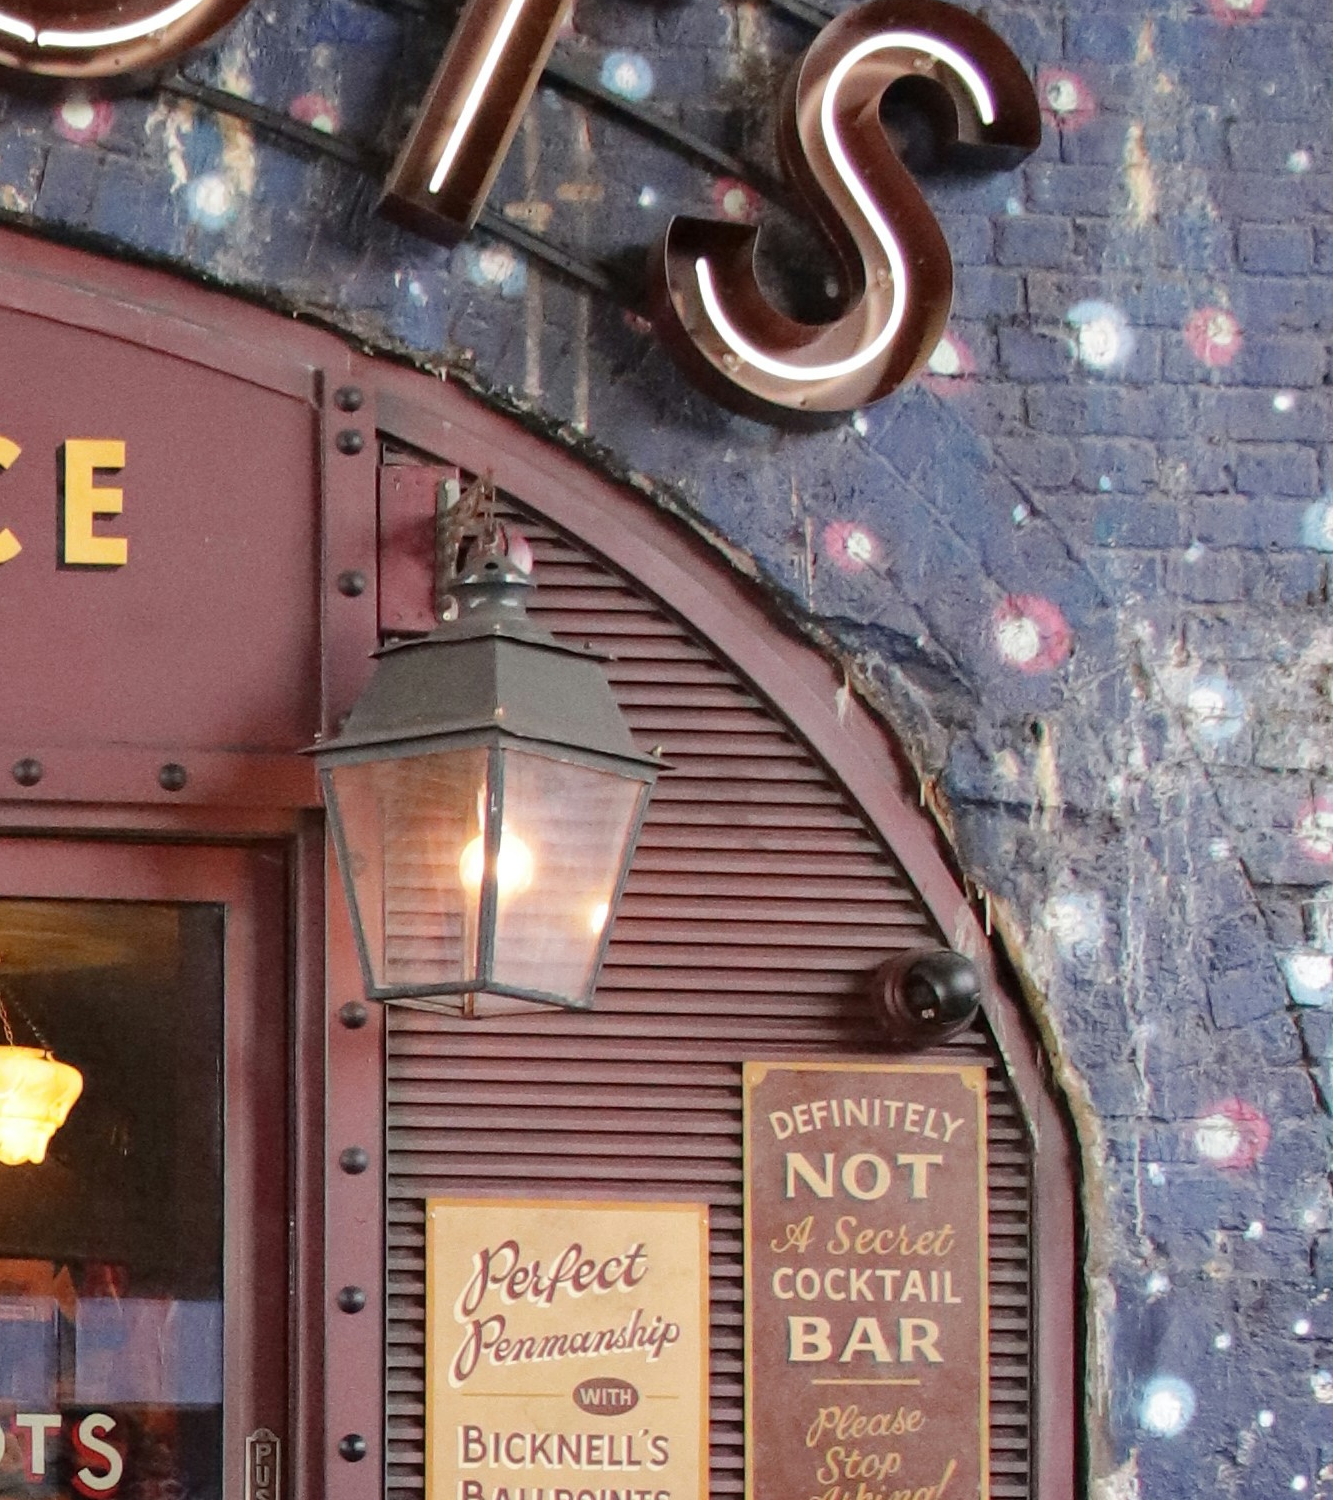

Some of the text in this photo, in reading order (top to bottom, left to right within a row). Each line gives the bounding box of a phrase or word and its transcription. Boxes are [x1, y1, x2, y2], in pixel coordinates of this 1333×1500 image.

[768, 1099, 965, 1144] DEFINITELY
[785, 1153, 943, 1200] NOT
[771, 1216, 955, 1257] A Secret
[453, 1239, 649, 1326] Perfect
[772, 1266, 962, 1304] COCKTAIL
[449, 1309, 680, 1389] Penmanship
[788, 1316, 944, 1363] BAR
[580, 1387, 632, 1406] WITH
[457, 1425, 669, 1471] BICKNELL'S
[807, 1406, 925, 1447] Please
[818, 1446, 900, 1487] Stop
